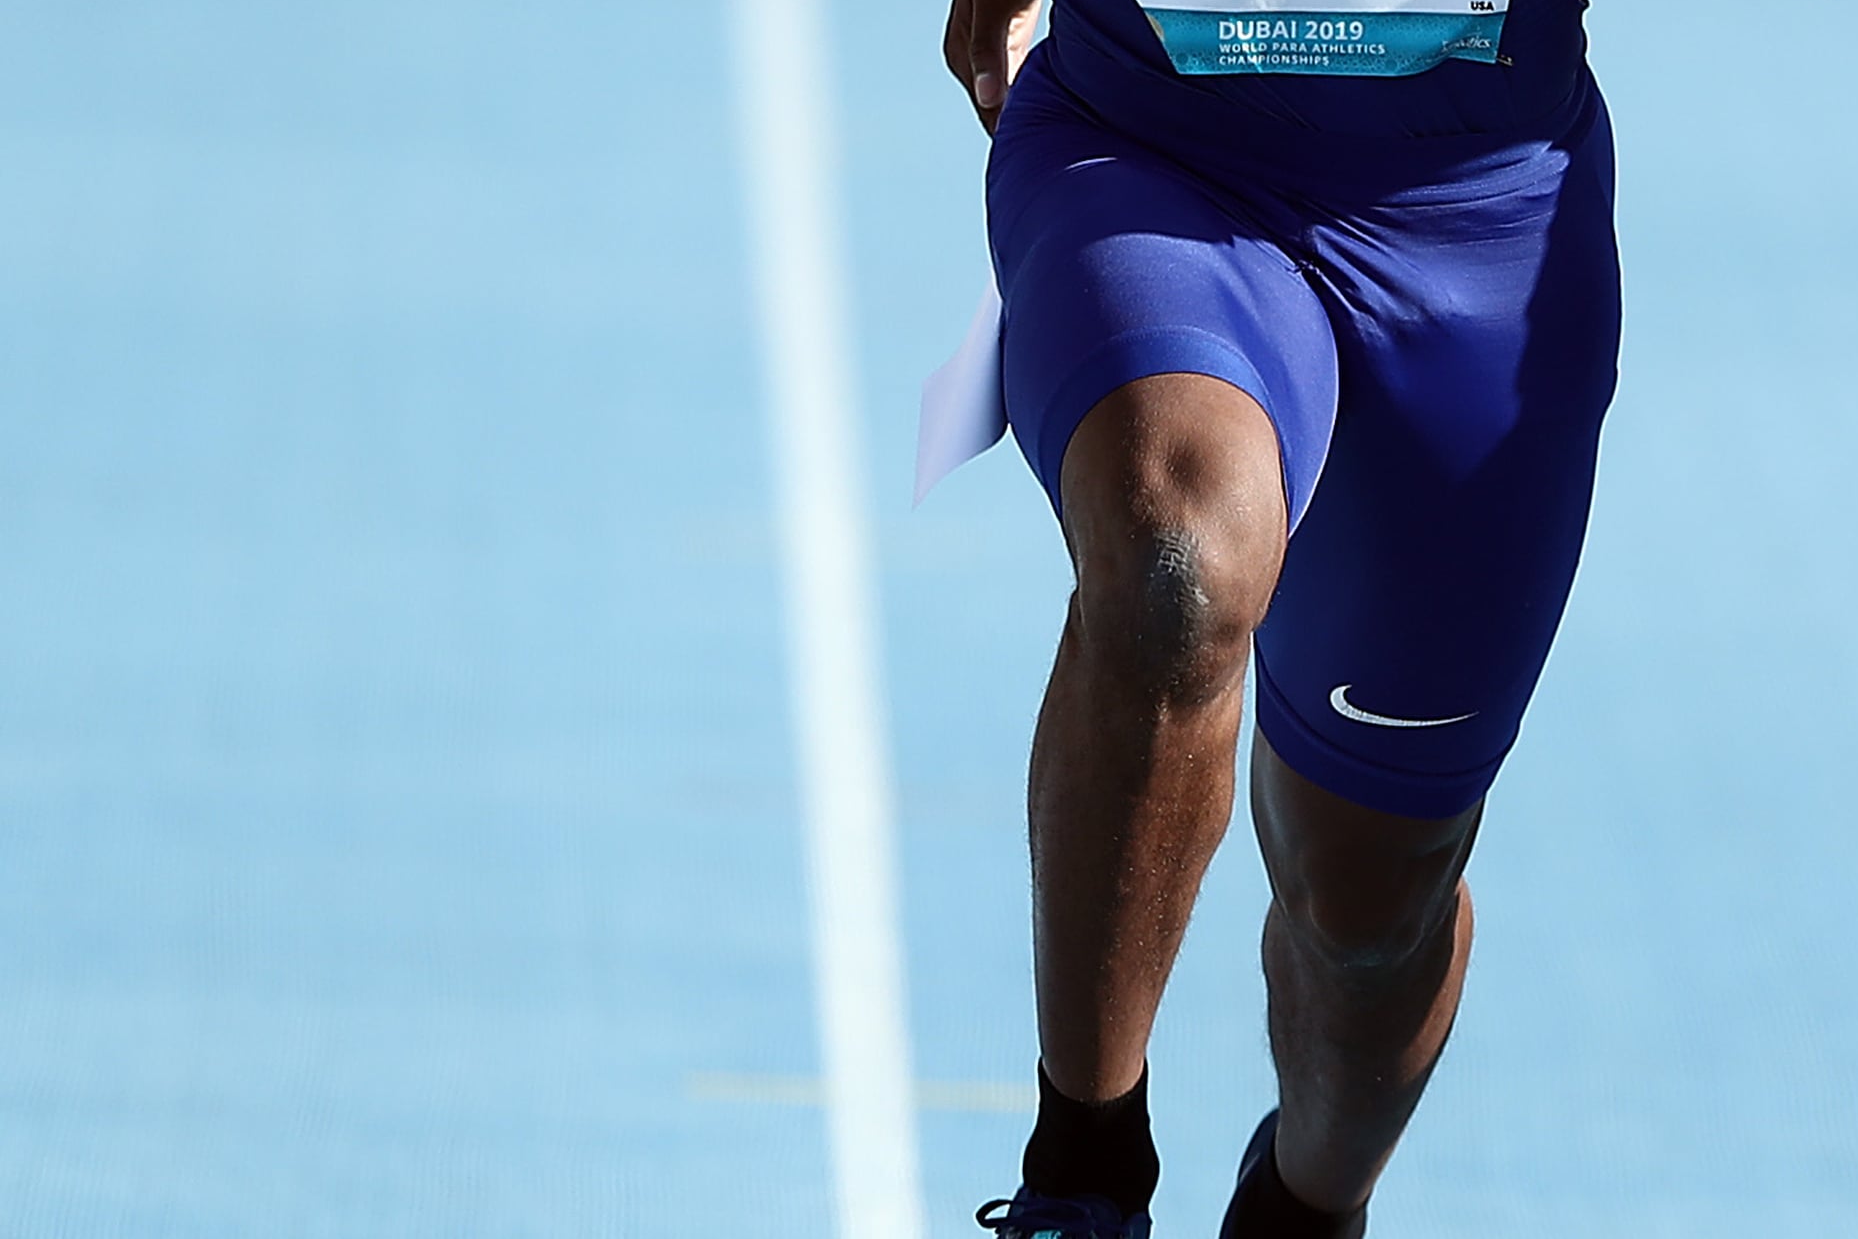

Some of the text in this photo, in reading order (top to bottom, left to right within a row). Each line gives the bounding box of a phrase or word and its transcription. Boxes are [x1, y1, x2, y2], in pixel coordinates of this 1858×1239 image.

[1470, 0, 1494, 11] USA
[1219, 20, 1364, 40] DUBAI 2019
[1219, 42, 1386, 55] WORLD PARA ATHLETICS
[1219, 54, 1330, 66] CHAMPIONSHIPS
